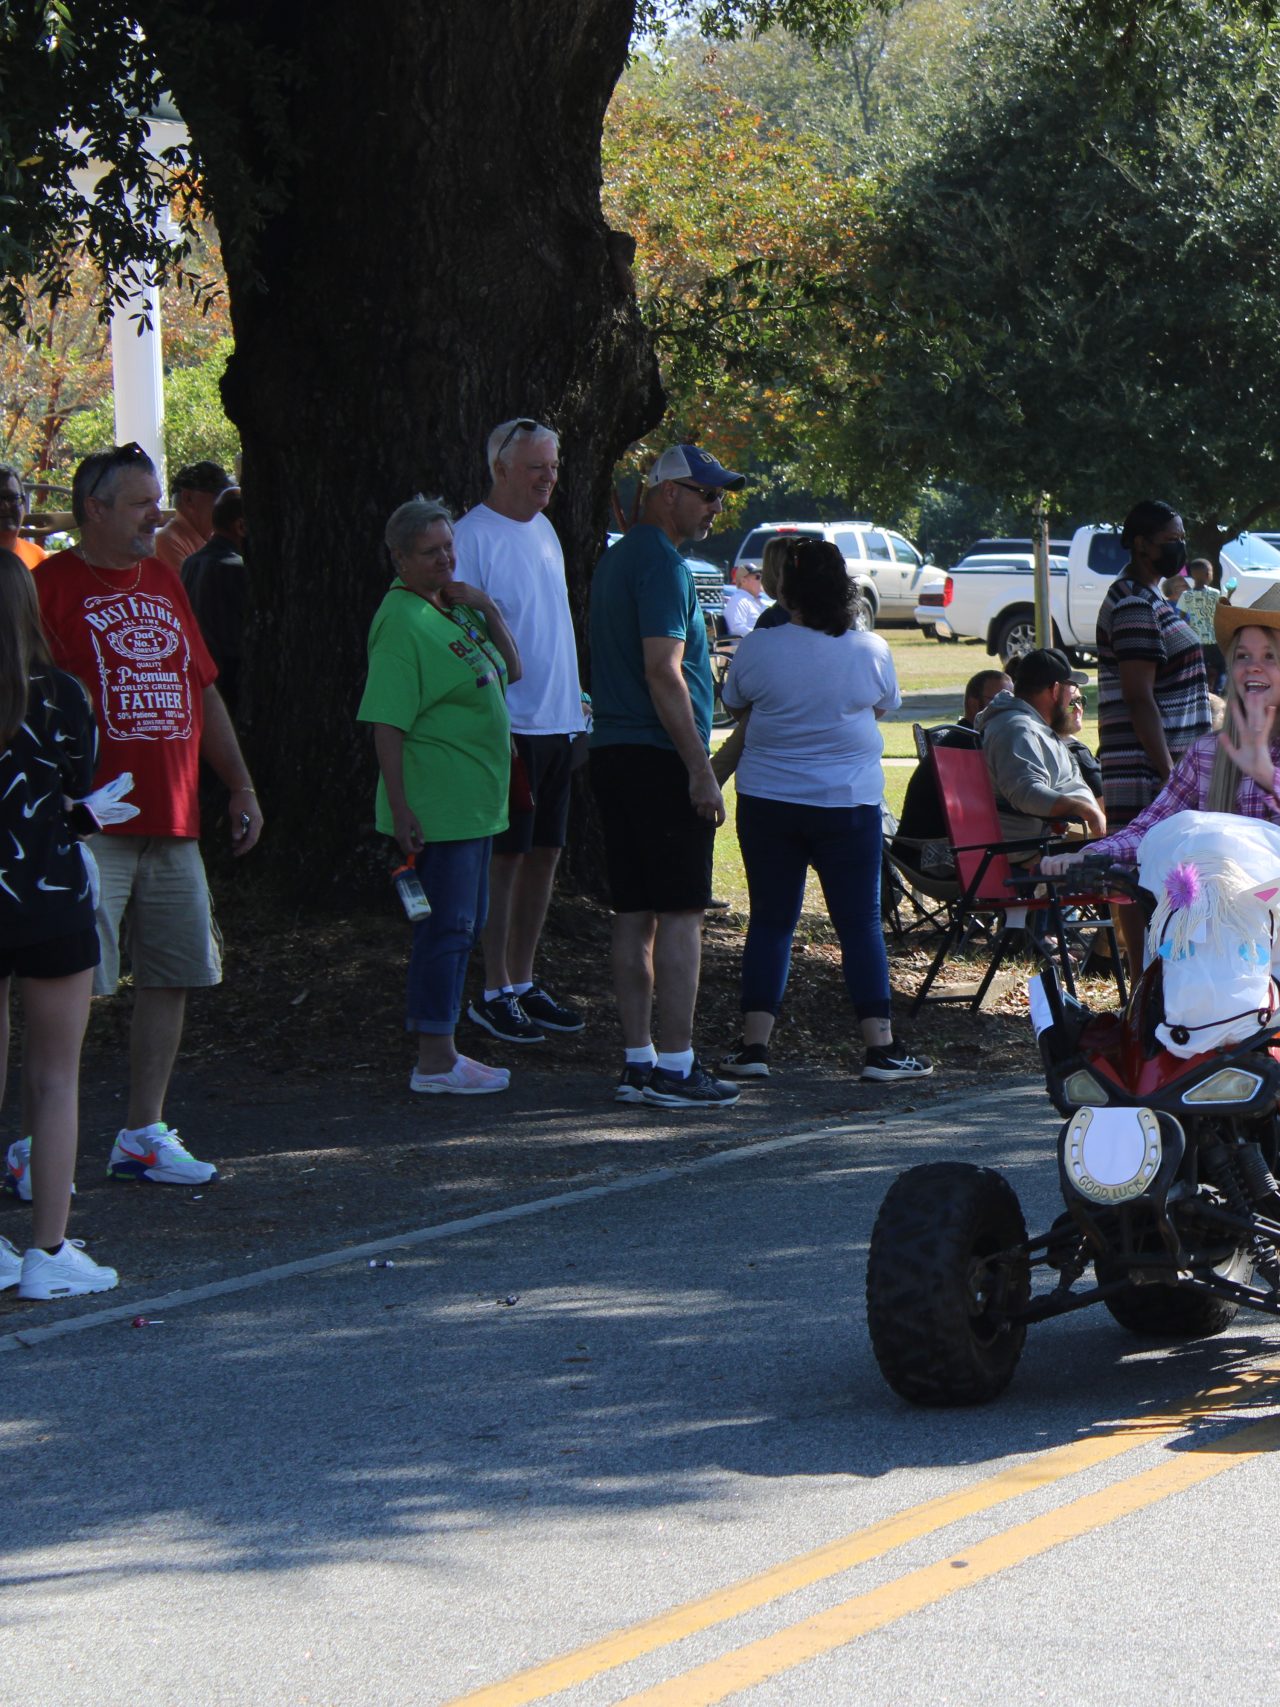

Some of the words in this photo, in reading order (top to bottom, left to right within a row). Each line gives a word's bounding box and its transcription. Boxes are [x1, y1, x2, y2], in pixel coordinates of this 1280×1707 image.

[84, 602, 128, 632] BEST
[134, 631, 155, 639] Dad
[153, 639, 159, 647] 1
[117, 666, 179, 684] Premium
[111, 684, 149, 692] WORLD'S
[120, 692, 182, 710] FATHER
[117, 712, 131, 720] 50%
[1079, 1175, 1109, 1199] GOOD
[1112, 1178, 1143, 1199] LUCK
